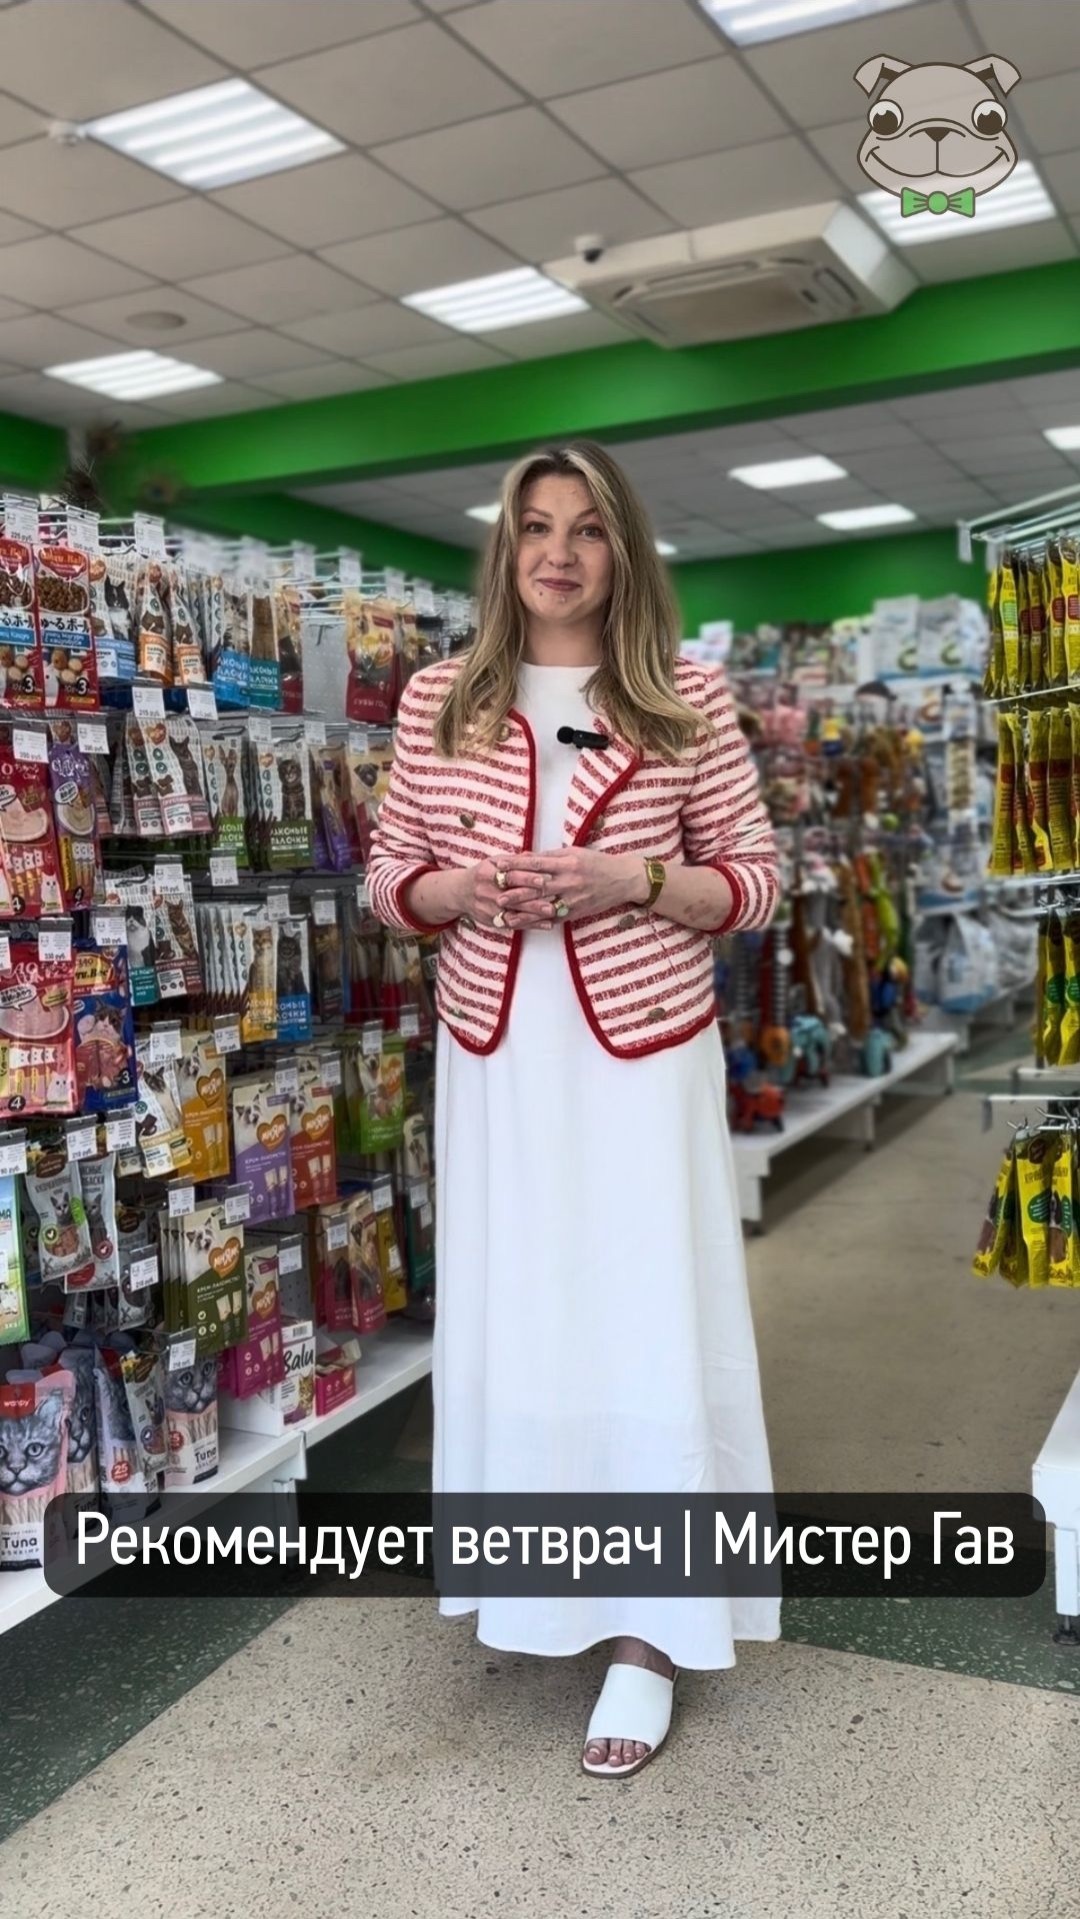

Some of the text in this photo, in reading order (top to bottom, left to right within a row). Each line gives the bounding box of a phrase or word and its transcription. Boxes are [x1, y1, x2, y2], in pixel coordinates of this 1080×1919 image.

[194, 1446, 217, 1464] Tuna
[114, 1462, 129, 1474] 25
[2, 1536, 38, 1549] Tuna
